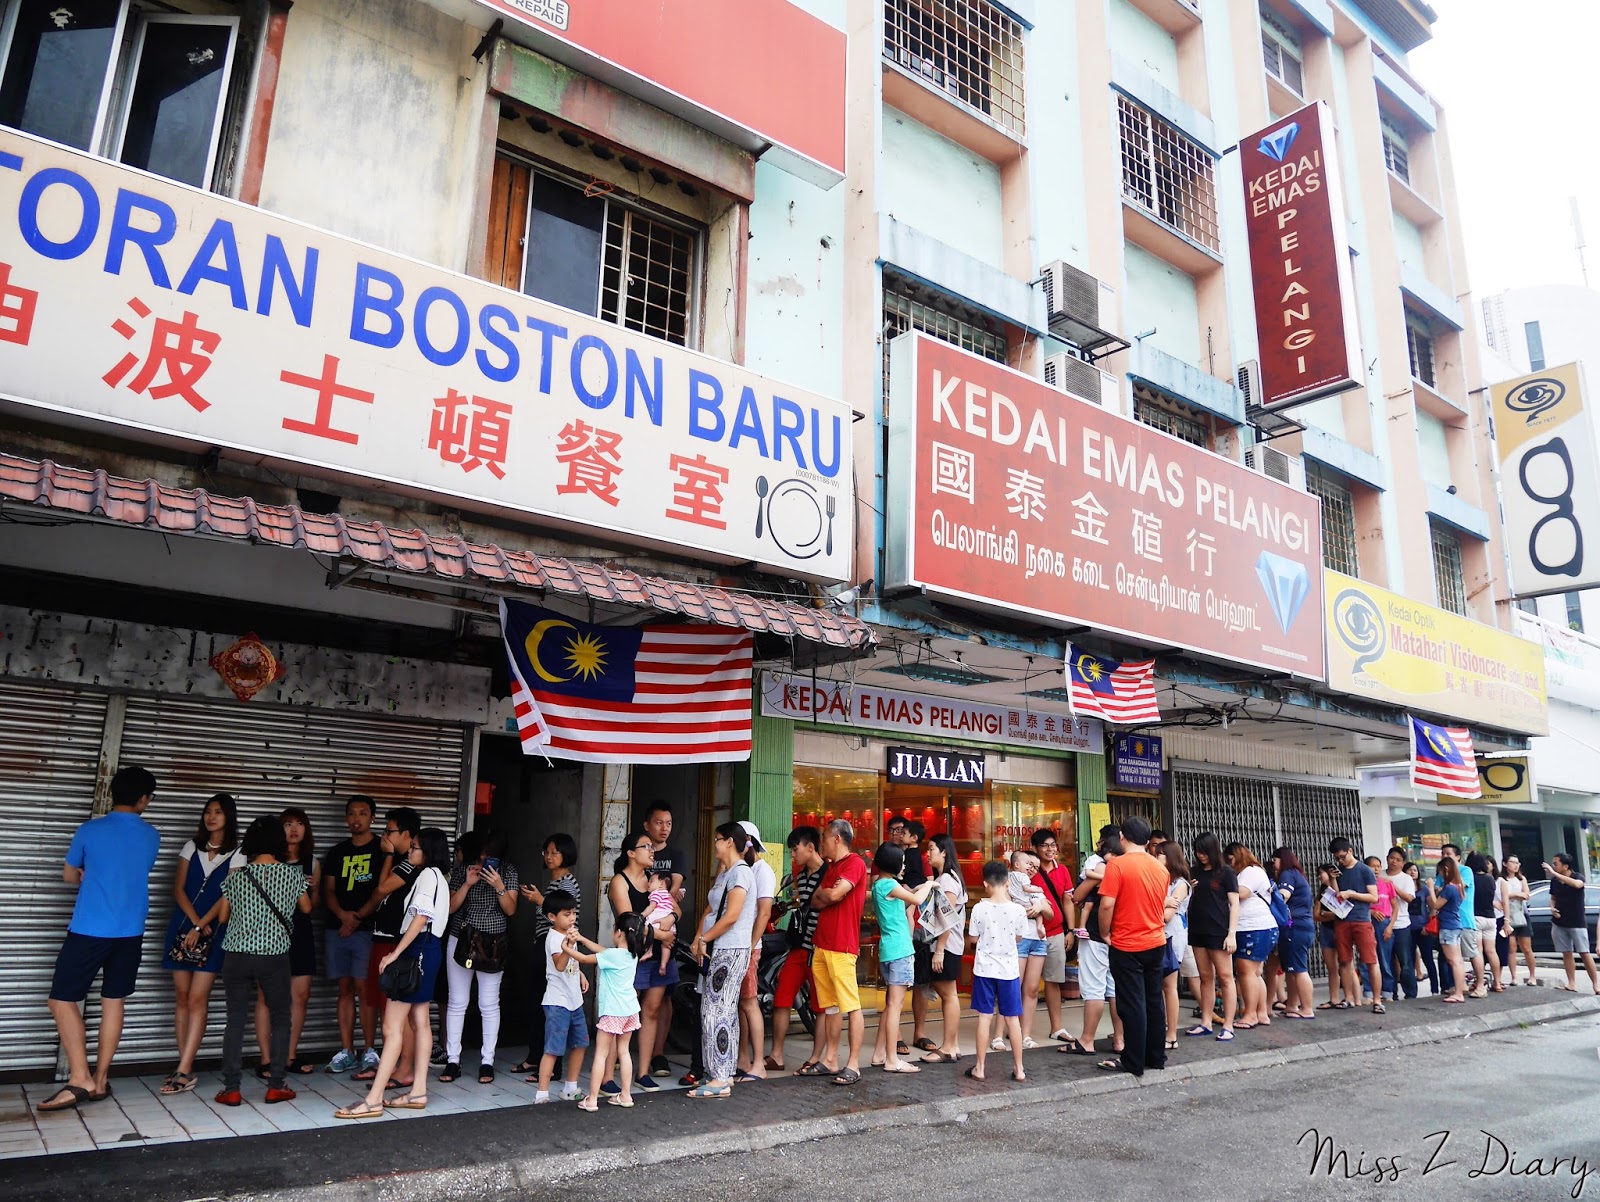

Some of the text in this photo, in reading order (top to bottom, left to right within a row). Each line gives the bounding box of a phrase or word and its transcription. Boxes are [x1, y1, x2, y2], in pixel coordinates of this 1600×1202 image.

[1248, 149, 1320, 199] KEDAI
[1252, 171, 1321, 218] EMAS
[1277, 207, 1317, 374] PELANGI
[350, 261, 664, 427] BOSTON
[688, 368, 842, 478] BARU
[932, 369, 1310, 554] KEDAI EMAS PELANGI
[1388, 601, 1435, 630] Kedai Optik
[1390, 622, 1447, 665] Matahari
[1449, 641, 1507, 681] Visioncare
[930, 706, 1002, 735] PELANGI
[891, 752, 985, 784] JUALAN
